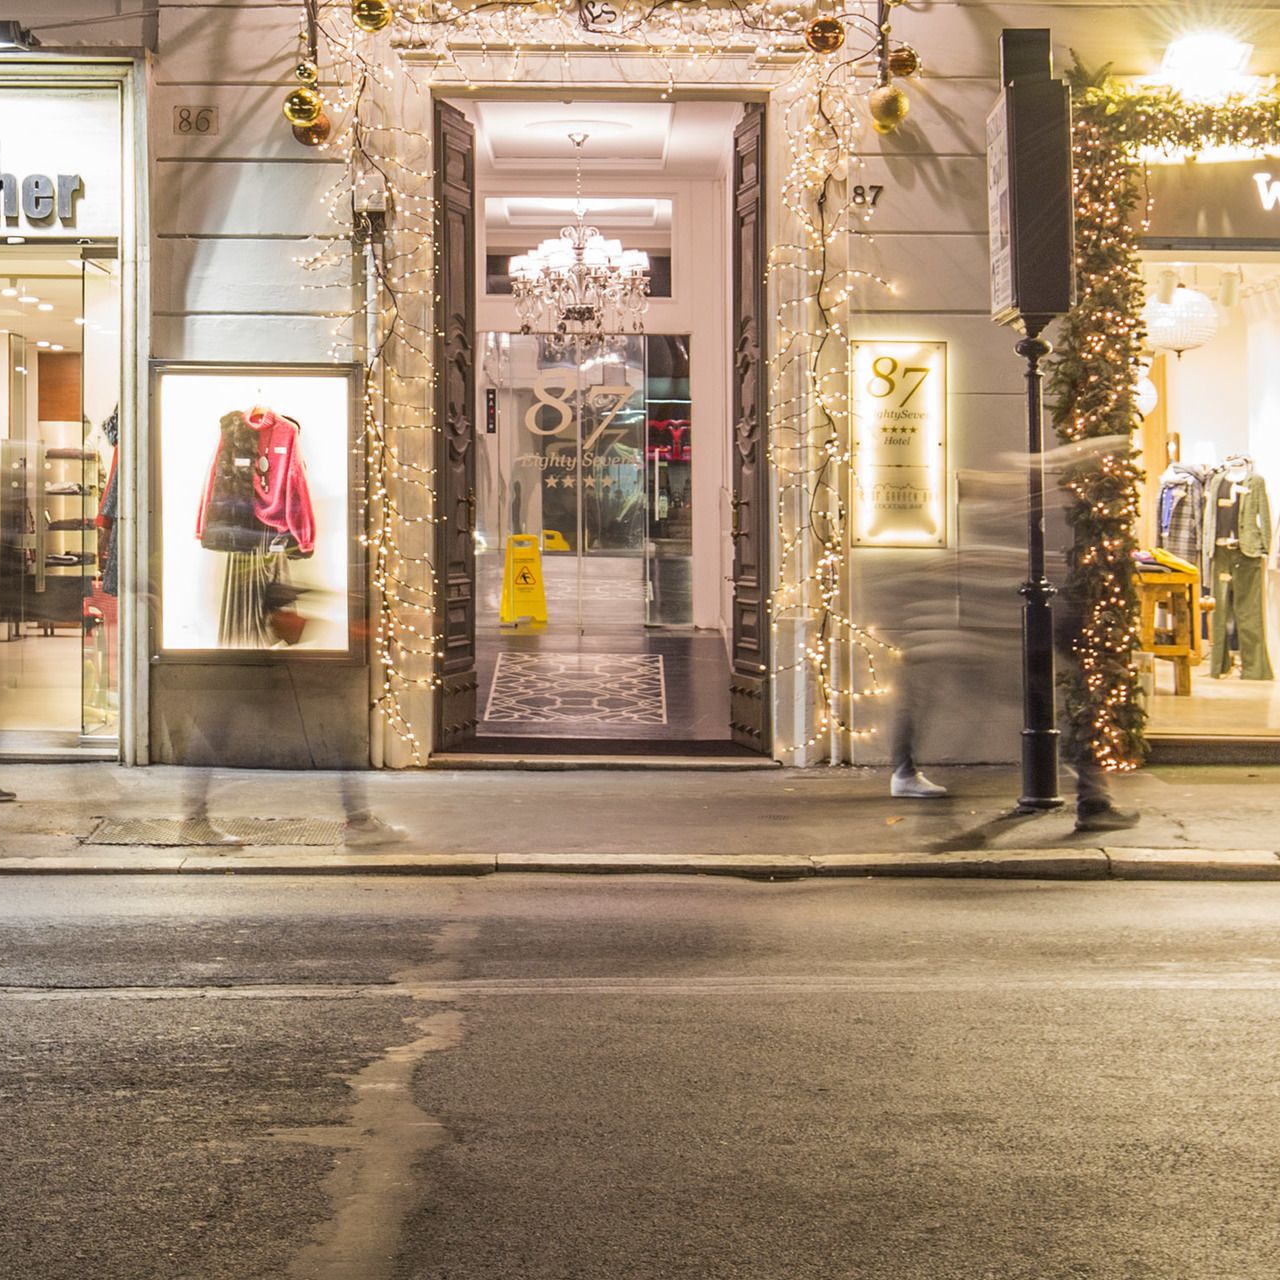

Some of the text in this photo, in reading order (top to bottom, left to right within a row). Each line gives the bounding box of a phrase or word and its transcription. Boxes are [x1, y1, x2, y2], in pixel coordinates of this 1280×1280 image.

[178, 108, 214, 133] 86
[852, 184, 885, 206] 87
[866, 356, 930, 408] 87
[524, 368, 636, 450] 87
[883, 436, 911, 446] Hotel
